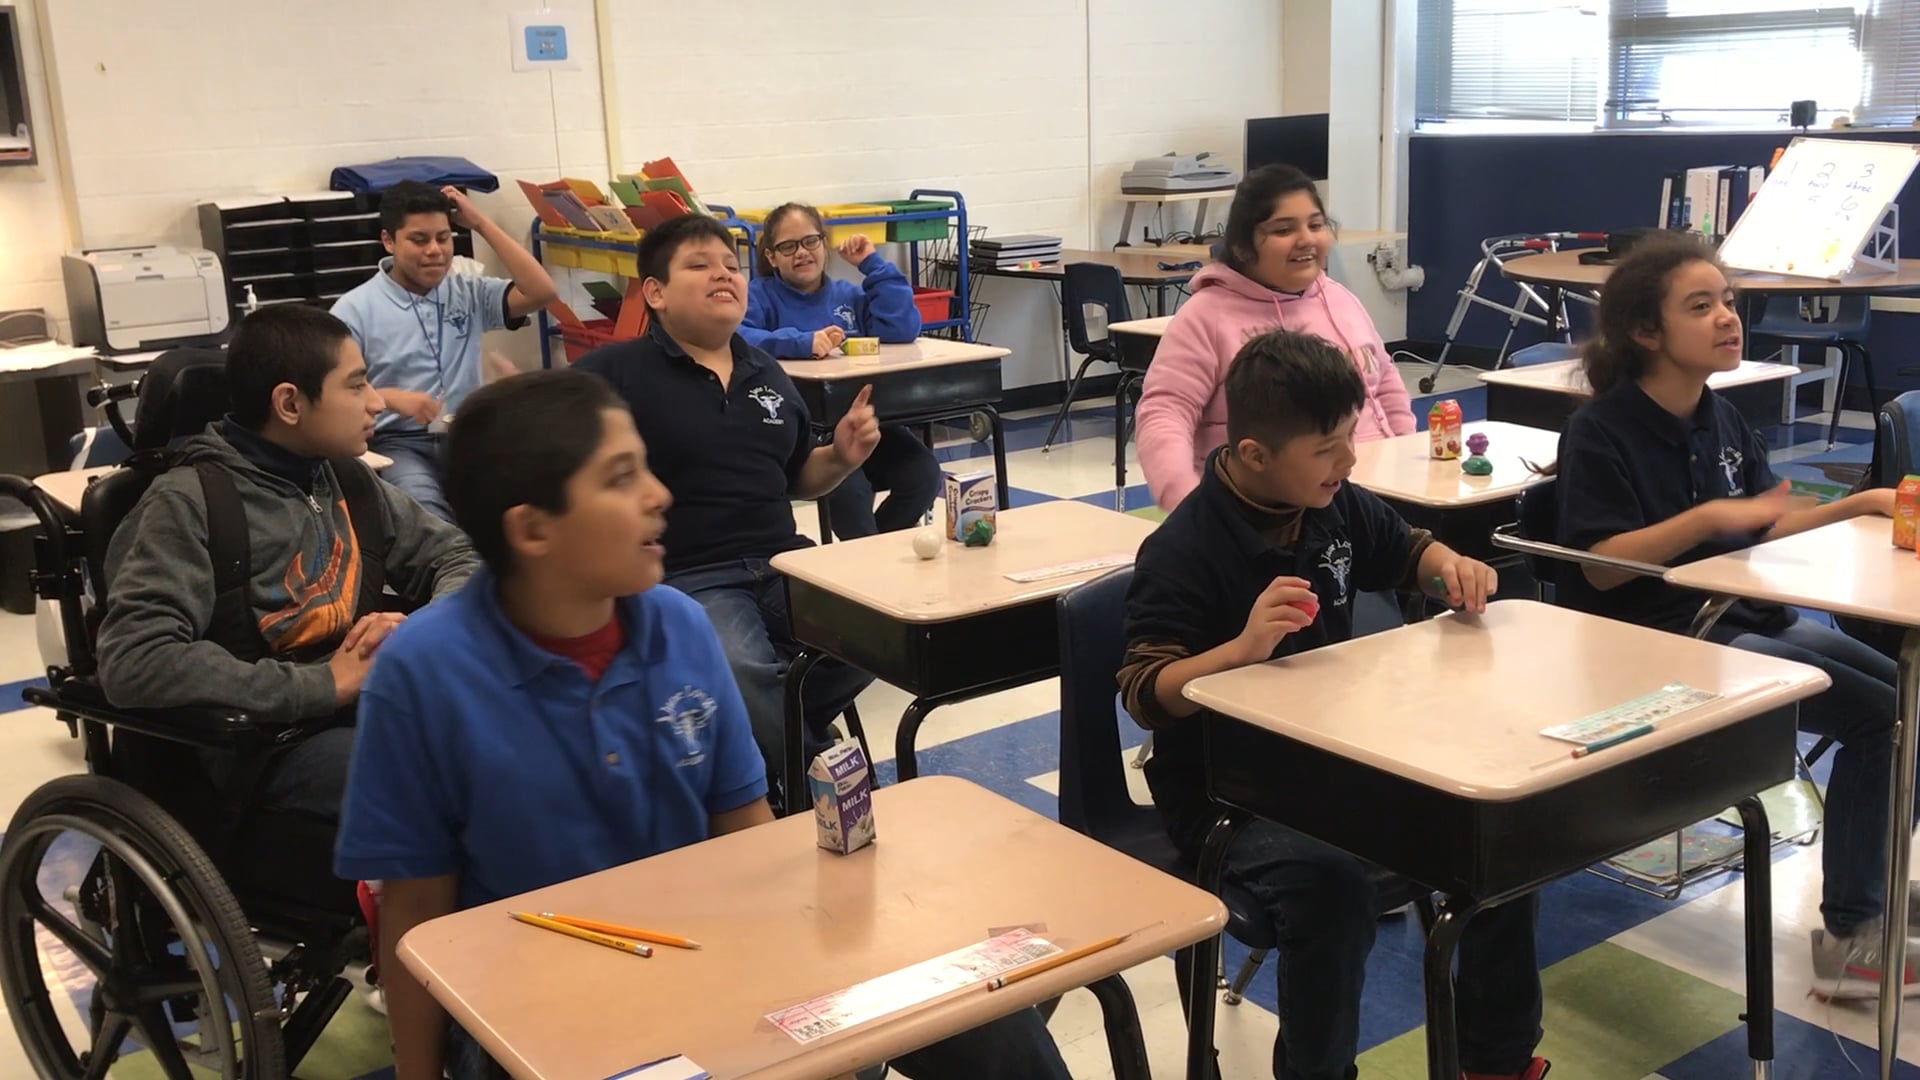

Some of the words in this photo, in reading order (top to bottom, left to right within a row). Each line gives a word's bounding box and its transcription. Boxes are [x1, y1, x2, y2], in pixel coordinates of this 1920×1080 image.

[1790, 160, 1799, 175] 1
[1816, 162, 1836, 180] 2
[1859, 163, 1875, 178] 3
[1808, 180, 1829, 189] two
[1845, 181, 1872, 193] three
[1840, 195, 1859, 211] 6
[965, 495, 992, 506] Crackers
[969, 489, 989, 498] Crispy
[834, 755, 860, 777] MILK
[841, 788, 869, 812] MILK
